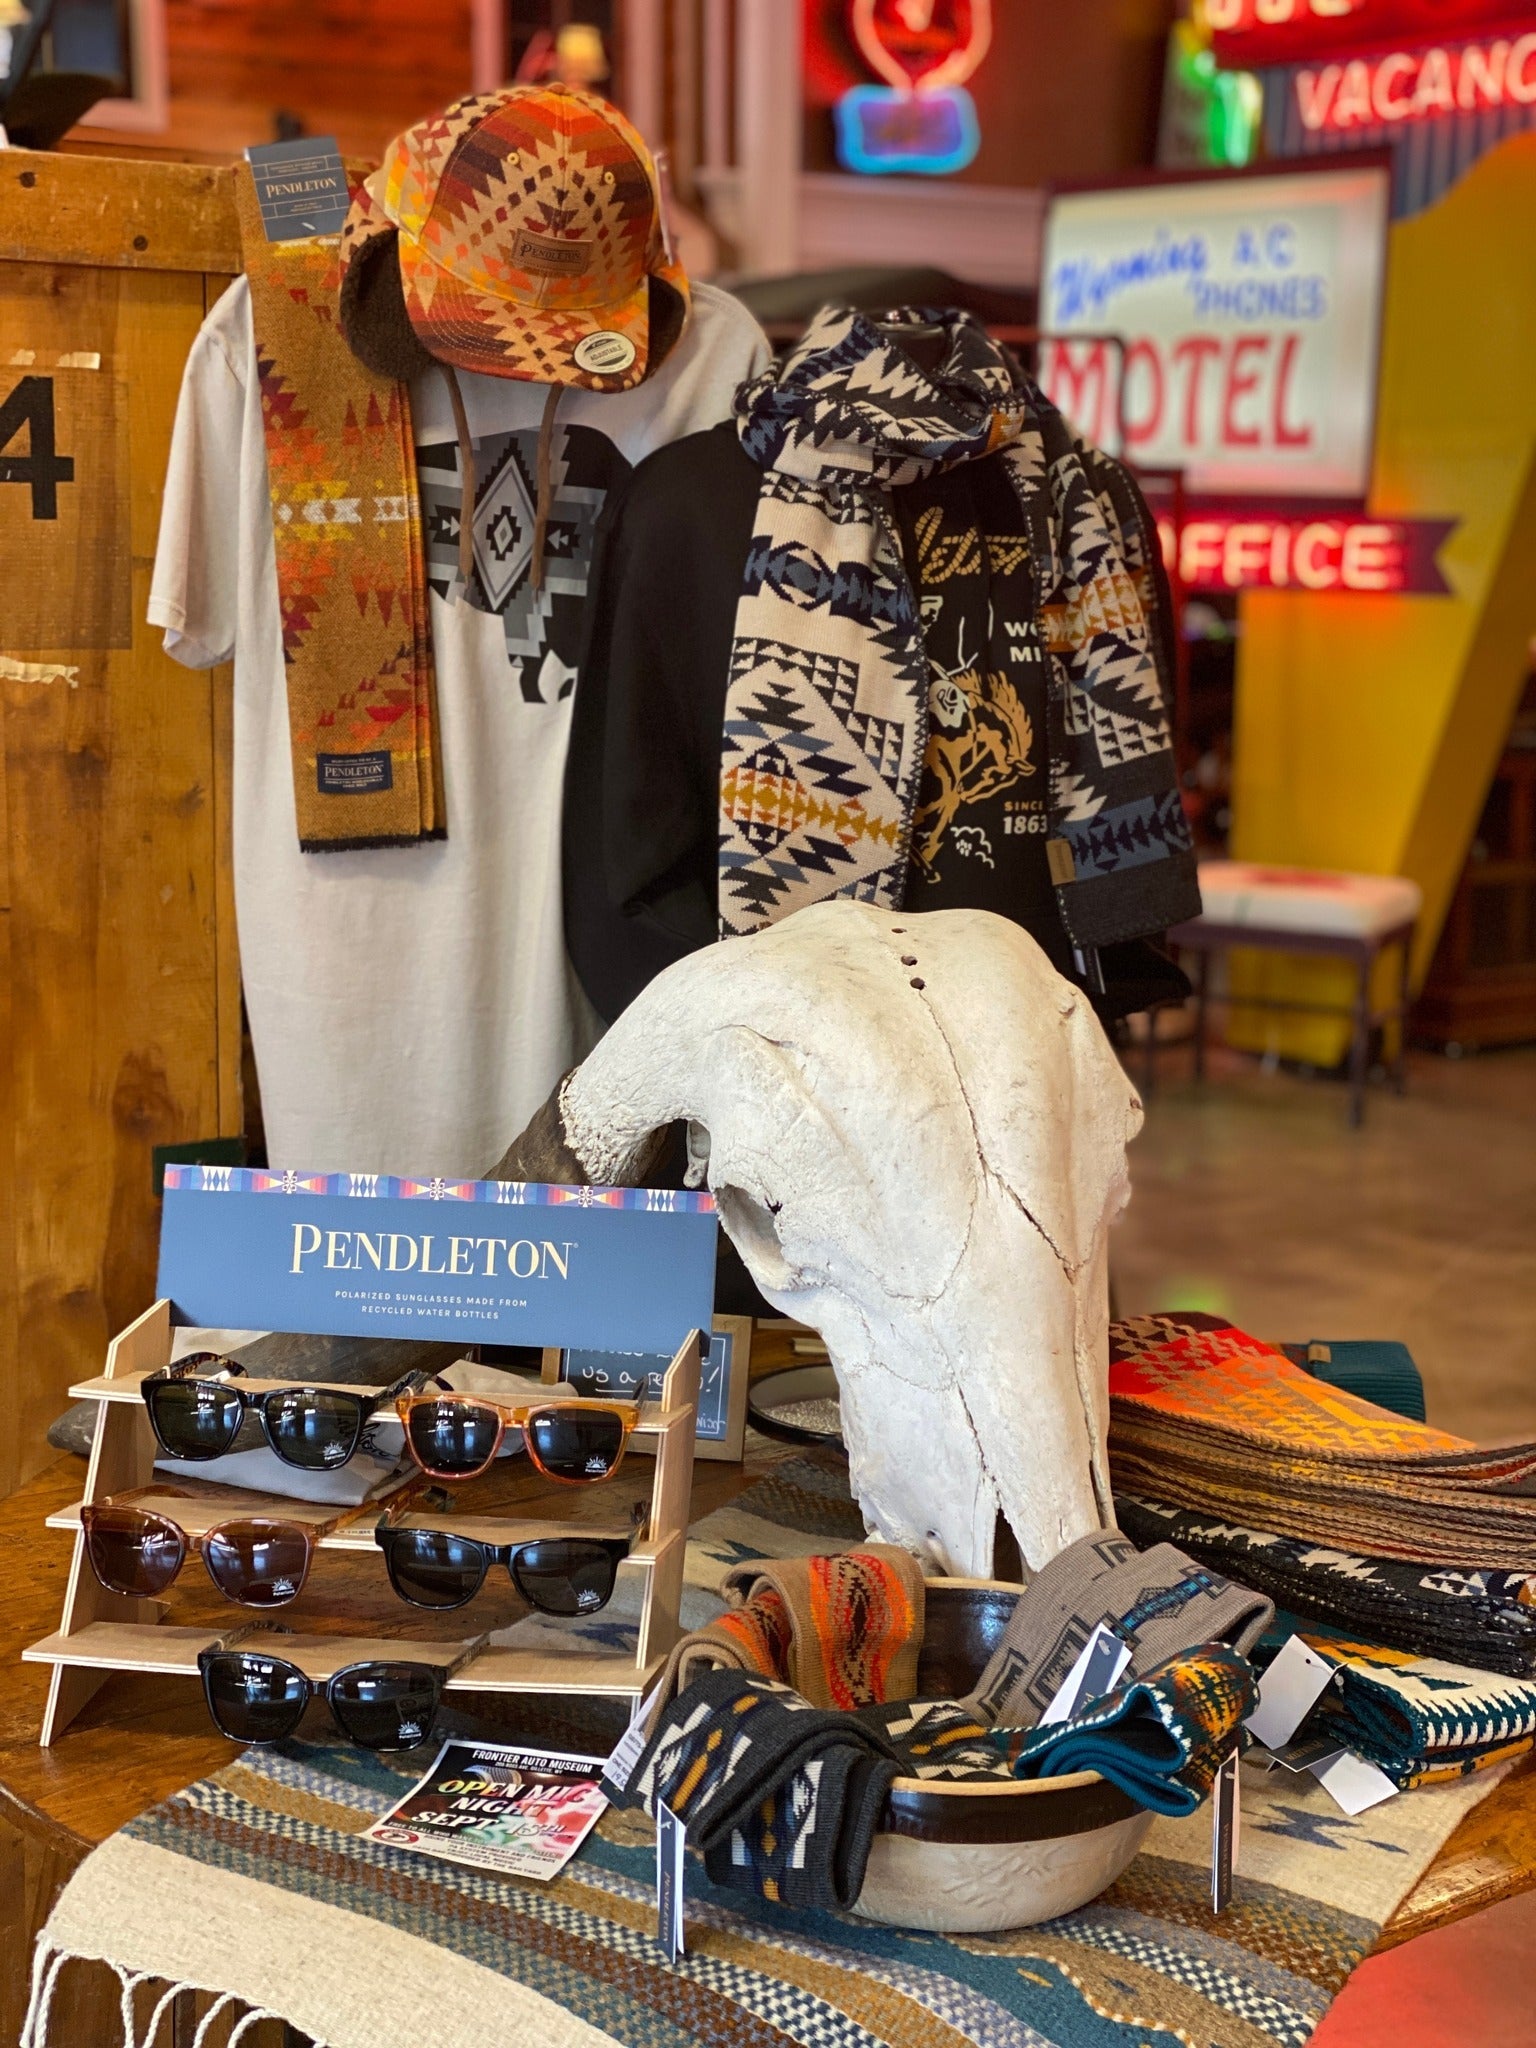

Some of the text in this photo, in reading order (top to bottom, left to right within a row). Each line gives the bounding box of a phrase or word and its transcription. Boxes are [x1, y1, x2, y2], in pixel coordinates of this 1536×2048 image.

[265, 177, 337, 198] PENDLETON
[520, 242, 581, 261] PENDLETON
[1047, 333, 1313, 450] MOTEL
[0, 376, 75, 520] 4
[324, 764, 383, 778] PENDLETON
[1003, 814, 1048, 834] 1863
[289, 1223, 573, 1280] PENDLETON
[335, 1290, 527, 1307] POLARIZED SUNGLASSES MADE FROM
[361, 1305, 499, 1320] RECYCLED WATER BOTTLES
[472, 1750, 593, 1774] FRONTIER AUTO MUSEUM
[438, 1780, 592, 1803] OPEN MIC
[449, 1797, 551, 1818] NIGHT
[411, 1811, 500, 1831] SEPT
